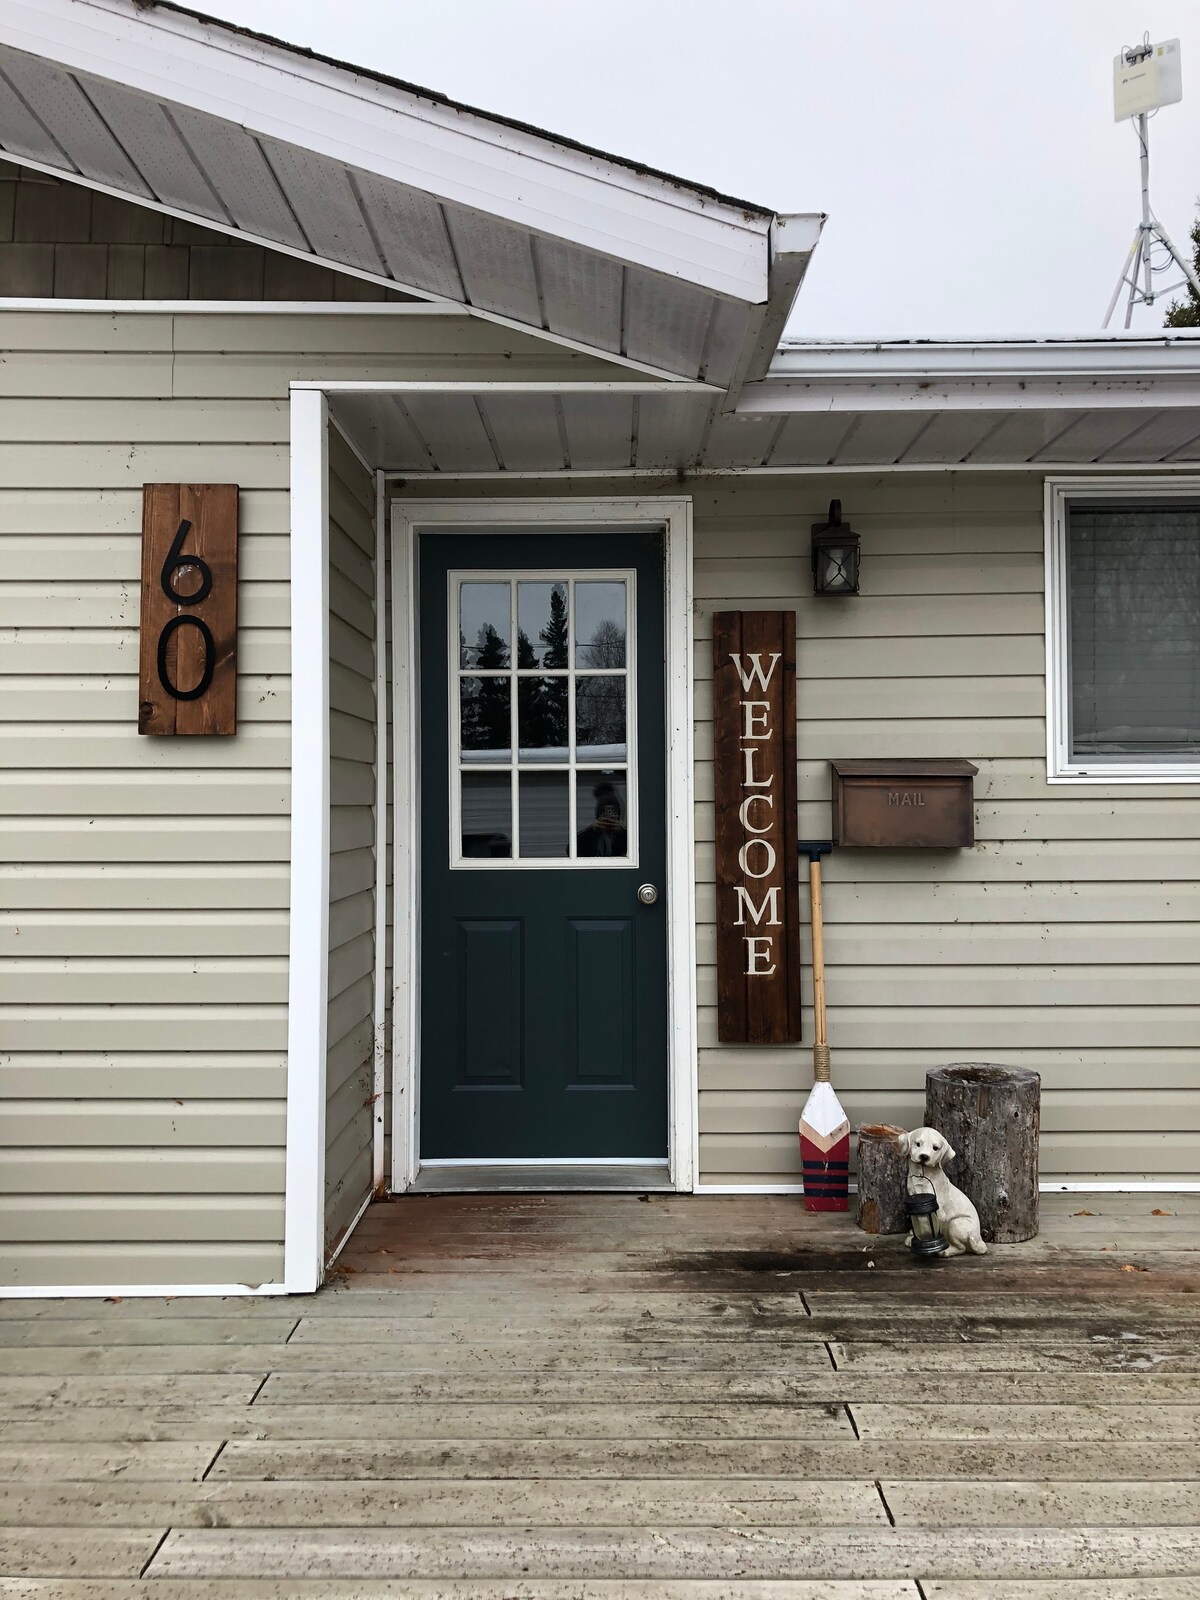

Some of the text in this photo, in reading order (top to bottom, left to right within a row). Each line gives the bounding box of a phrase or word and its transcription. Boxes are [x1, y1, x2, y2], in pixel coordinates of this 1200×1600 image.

[158, 519, 214, 700] 60
[729, 653, 782, 975] WELCOME
[888, 792, 925, 806] MAIL
